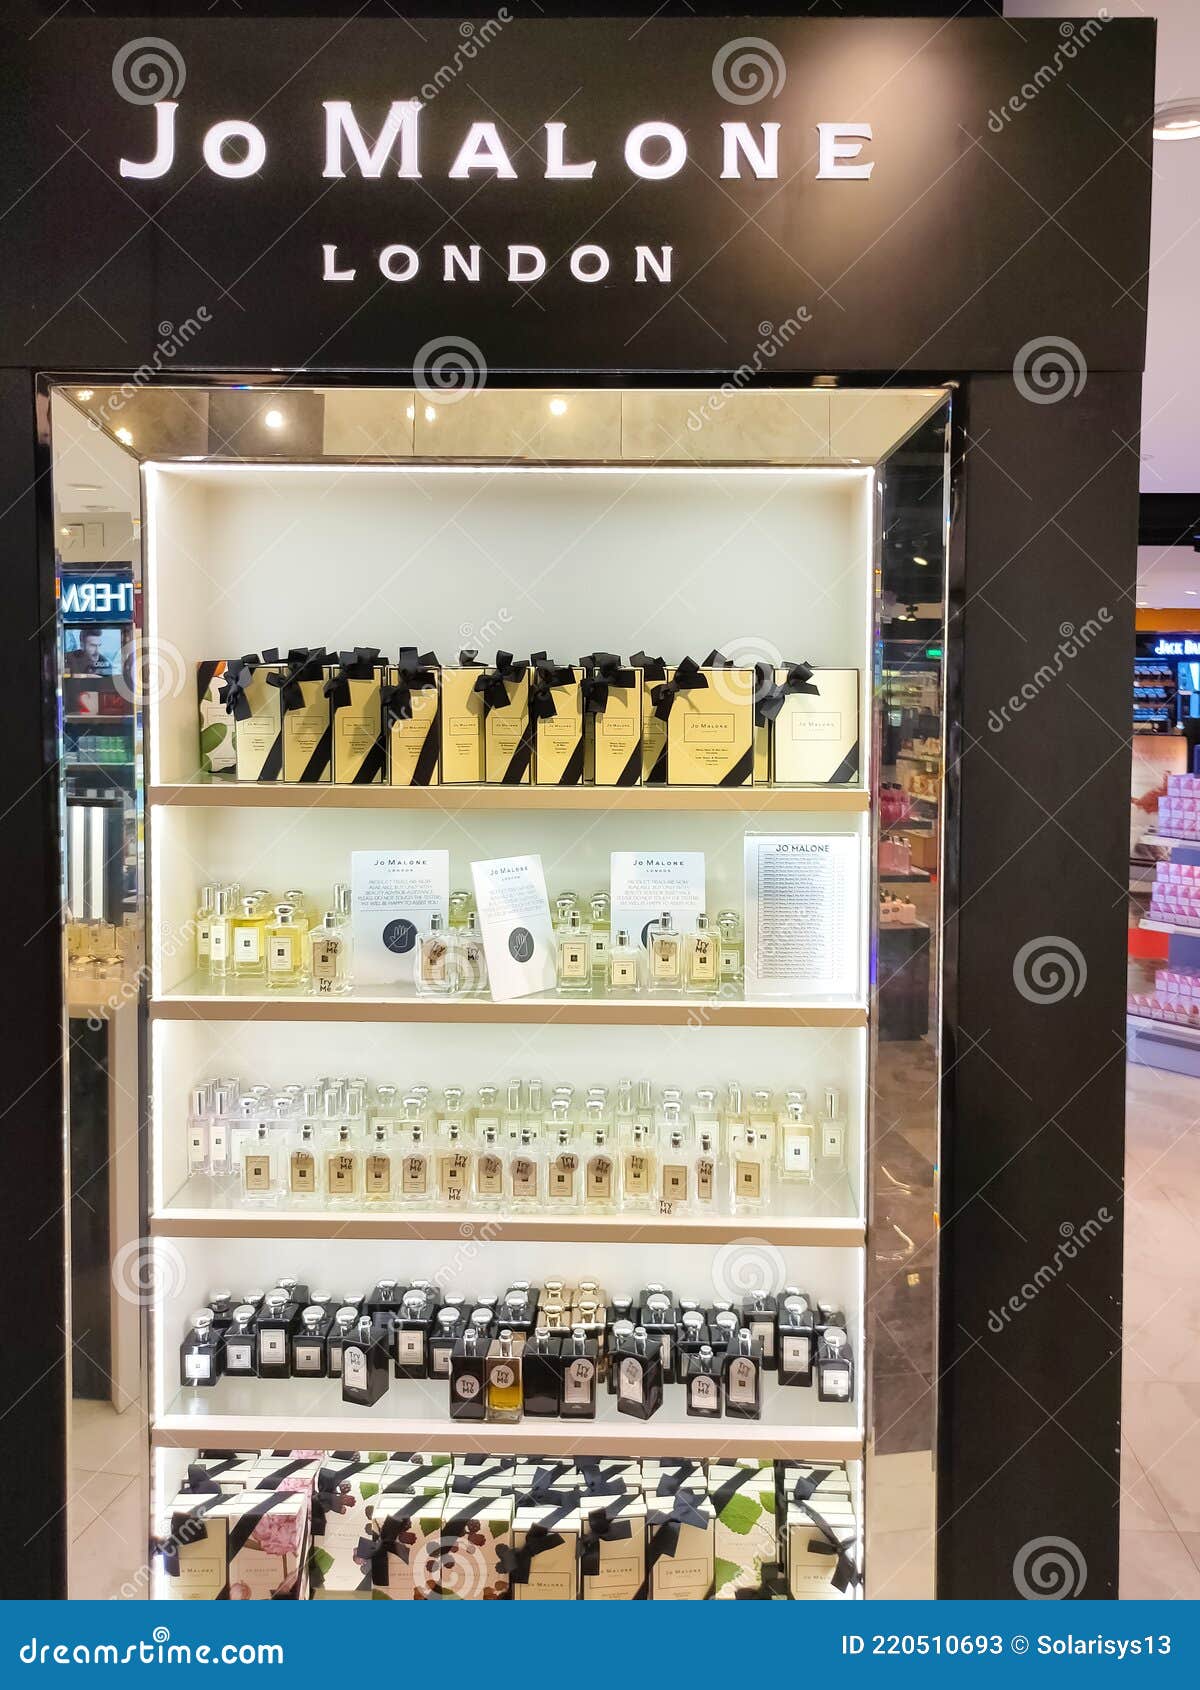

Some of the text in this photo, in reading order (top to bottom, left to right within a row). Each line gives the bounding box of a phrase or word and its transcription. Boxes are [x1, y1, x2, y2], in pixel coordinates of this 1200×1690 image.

[322, 101, 875, 179] MALONE
[322, 245, 673, 283] LONDON
[792, 843, 830, 852] MALONE
